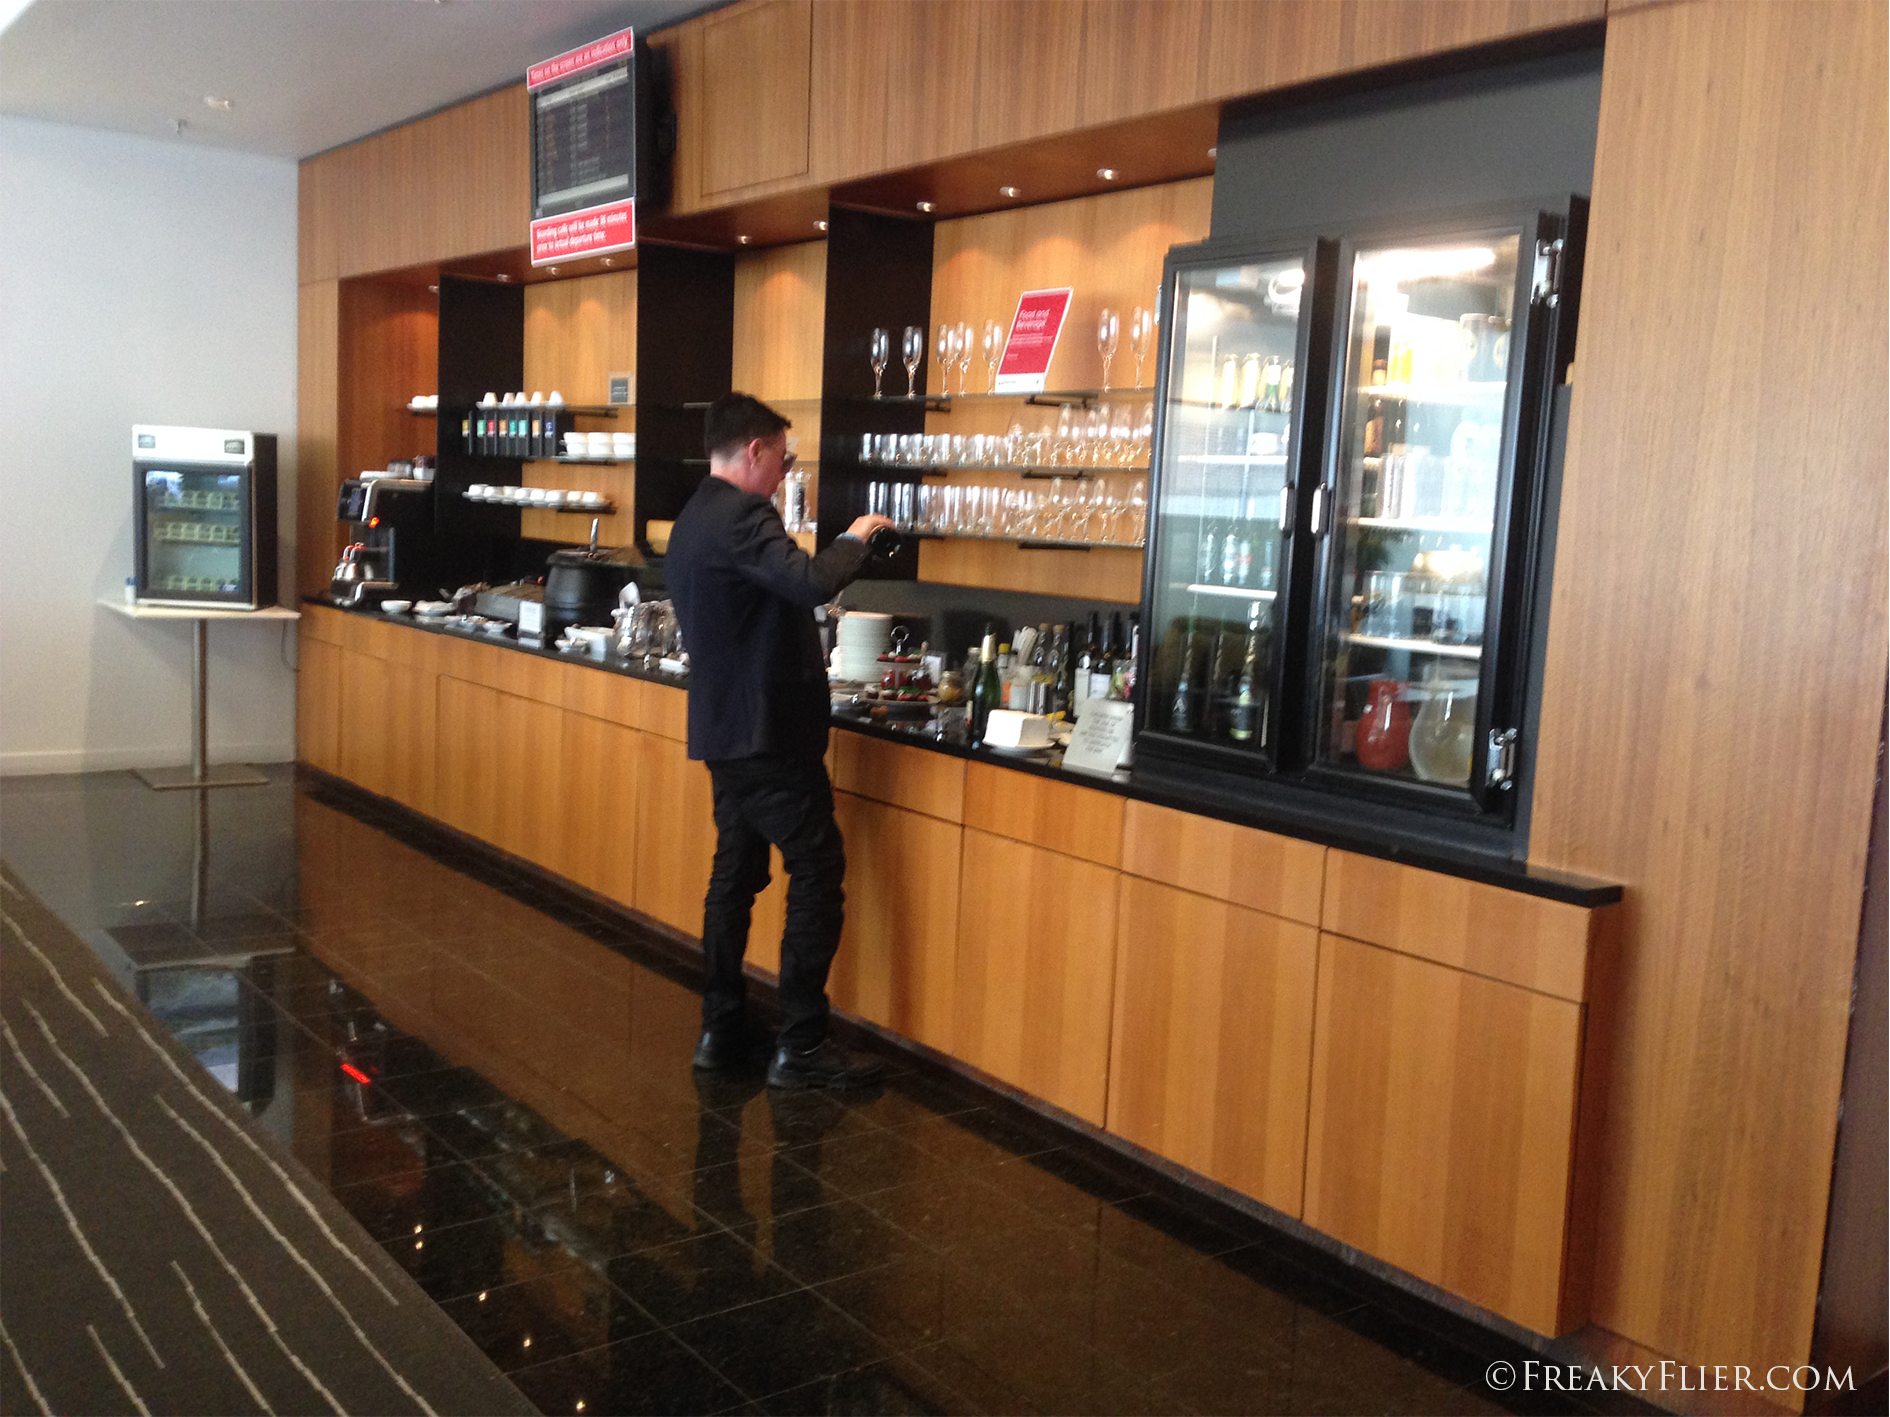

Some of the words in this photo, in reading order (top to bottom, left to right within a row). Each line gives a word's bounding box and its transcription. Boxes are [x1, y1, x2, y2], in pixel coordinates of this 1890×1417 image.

[537, 227, 557, 239] Boarding
[606, 211, 628, 223] minutes
[1019, 309, 1036, 319] Food
[1036, 308, 1051, 318] and
